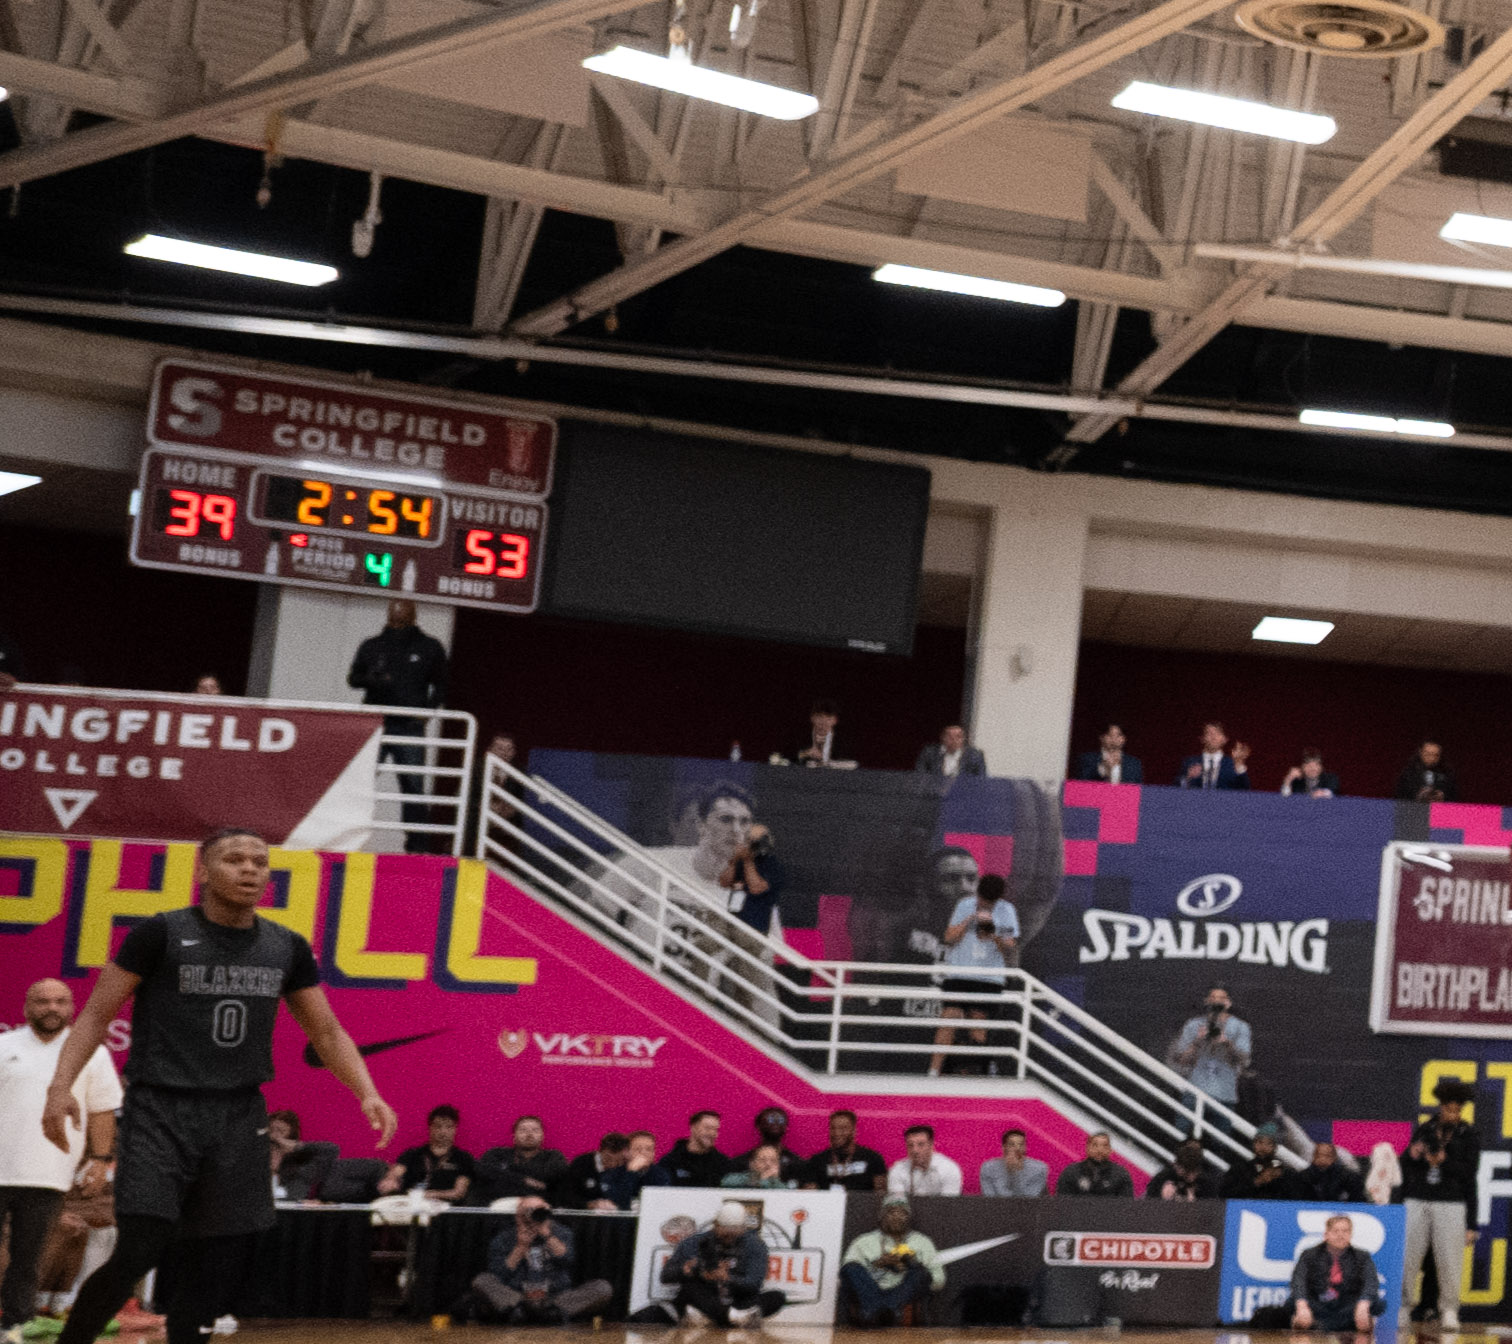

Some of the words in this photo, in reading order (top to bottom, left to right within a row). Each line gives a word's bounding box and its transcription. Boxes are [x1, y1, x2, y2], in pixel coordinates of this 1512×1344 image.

[234, 389, 488, 447] SPRINGFIELD
[272, 424, 446, 468] COLLEGE
[163, 460, 237, 488] HOME
[165, 489, 237, 541] 39
[298, 480, 432, 538] 2:54
[449, 498, 540, 528] VISITOR
[179, 544, 241, 568] BONUS
[292, 547, 356, 571] PERIOD
[365, 552, 392, 587] 4
[464, 529, 530, 579] 53
[438, 575, 496, 598] BONUS
[1079, 908, 1329, 974] SPALDING
[179, 964, 284, 997] BLAZERS
[212, 999, 247, 1047] 0
[532, 1033, 667, 1057] VKTRY
[1083, 1238, 1205, 1262] CHIPOTLE
